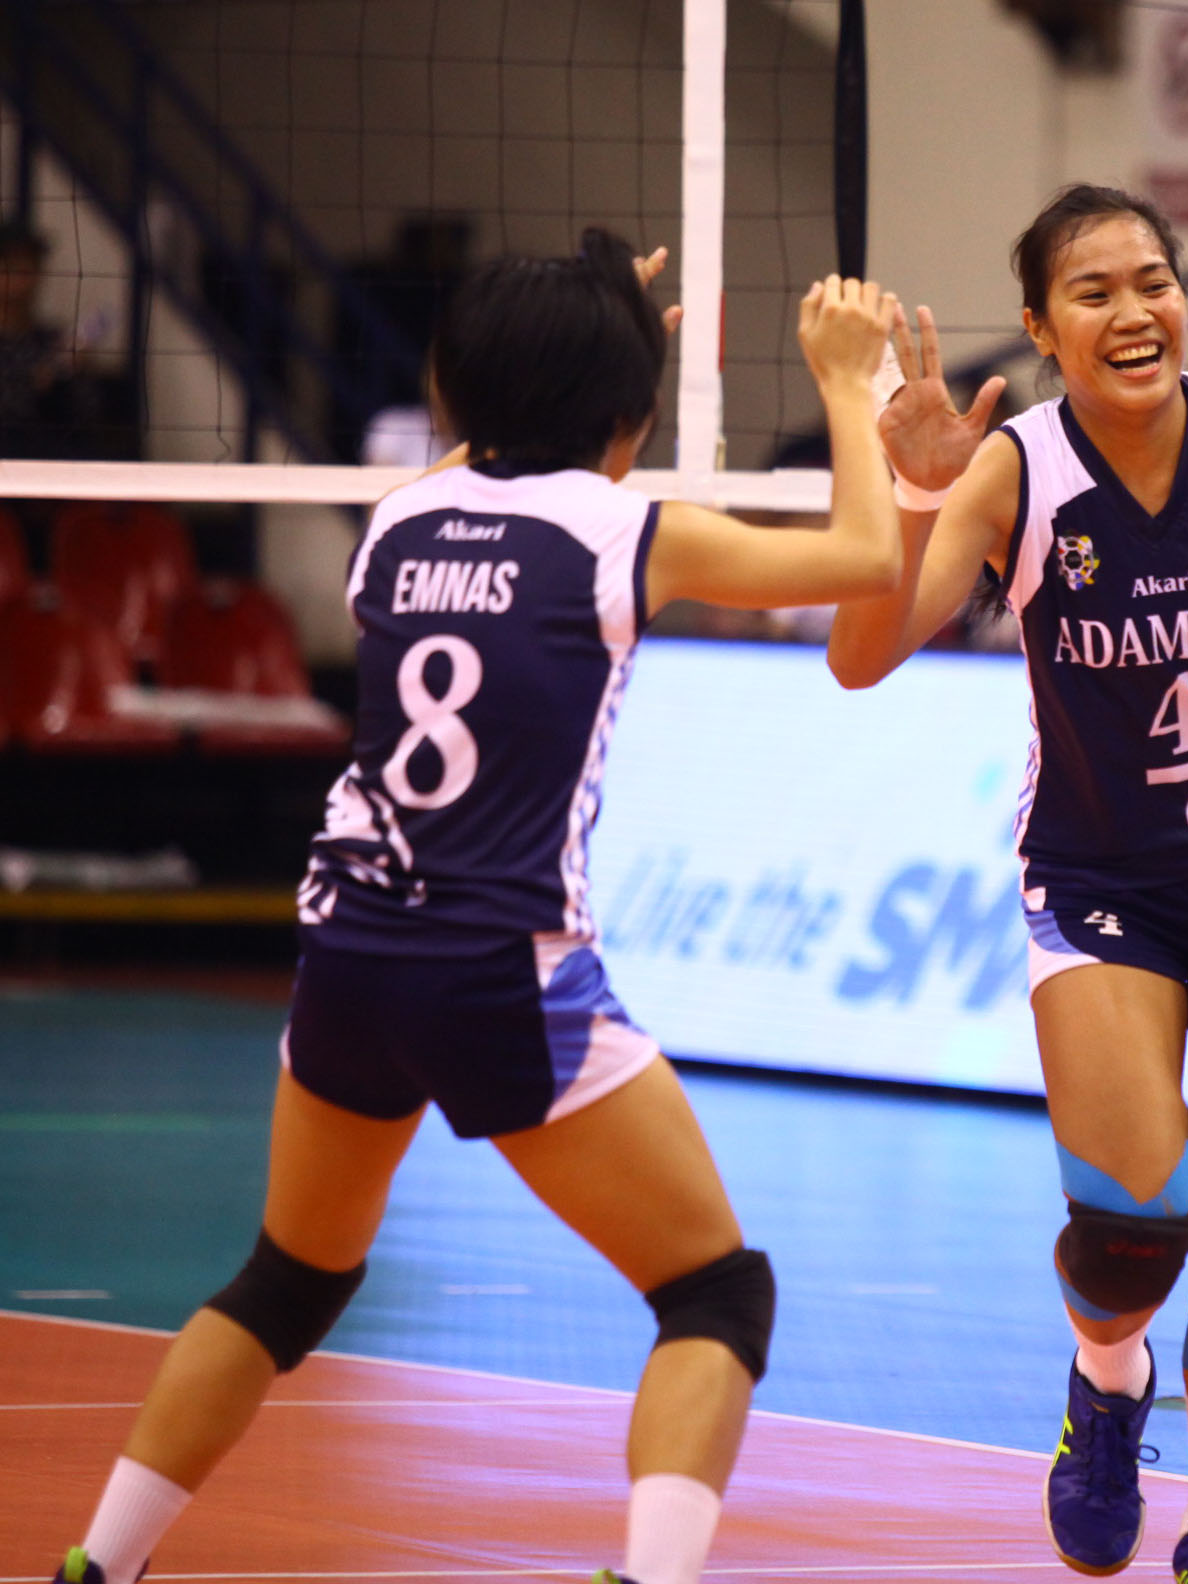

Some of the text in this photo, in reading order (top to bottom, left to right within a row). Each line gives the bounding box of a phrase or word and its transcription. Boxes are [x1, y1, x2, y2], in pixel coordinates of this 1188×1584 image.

[433, 518, 507, 541] Akari
[392, 559, 520, 614] EMNAS
[382, 634, 483, 810] 8
[1084, 910, 1123, 936] 4
